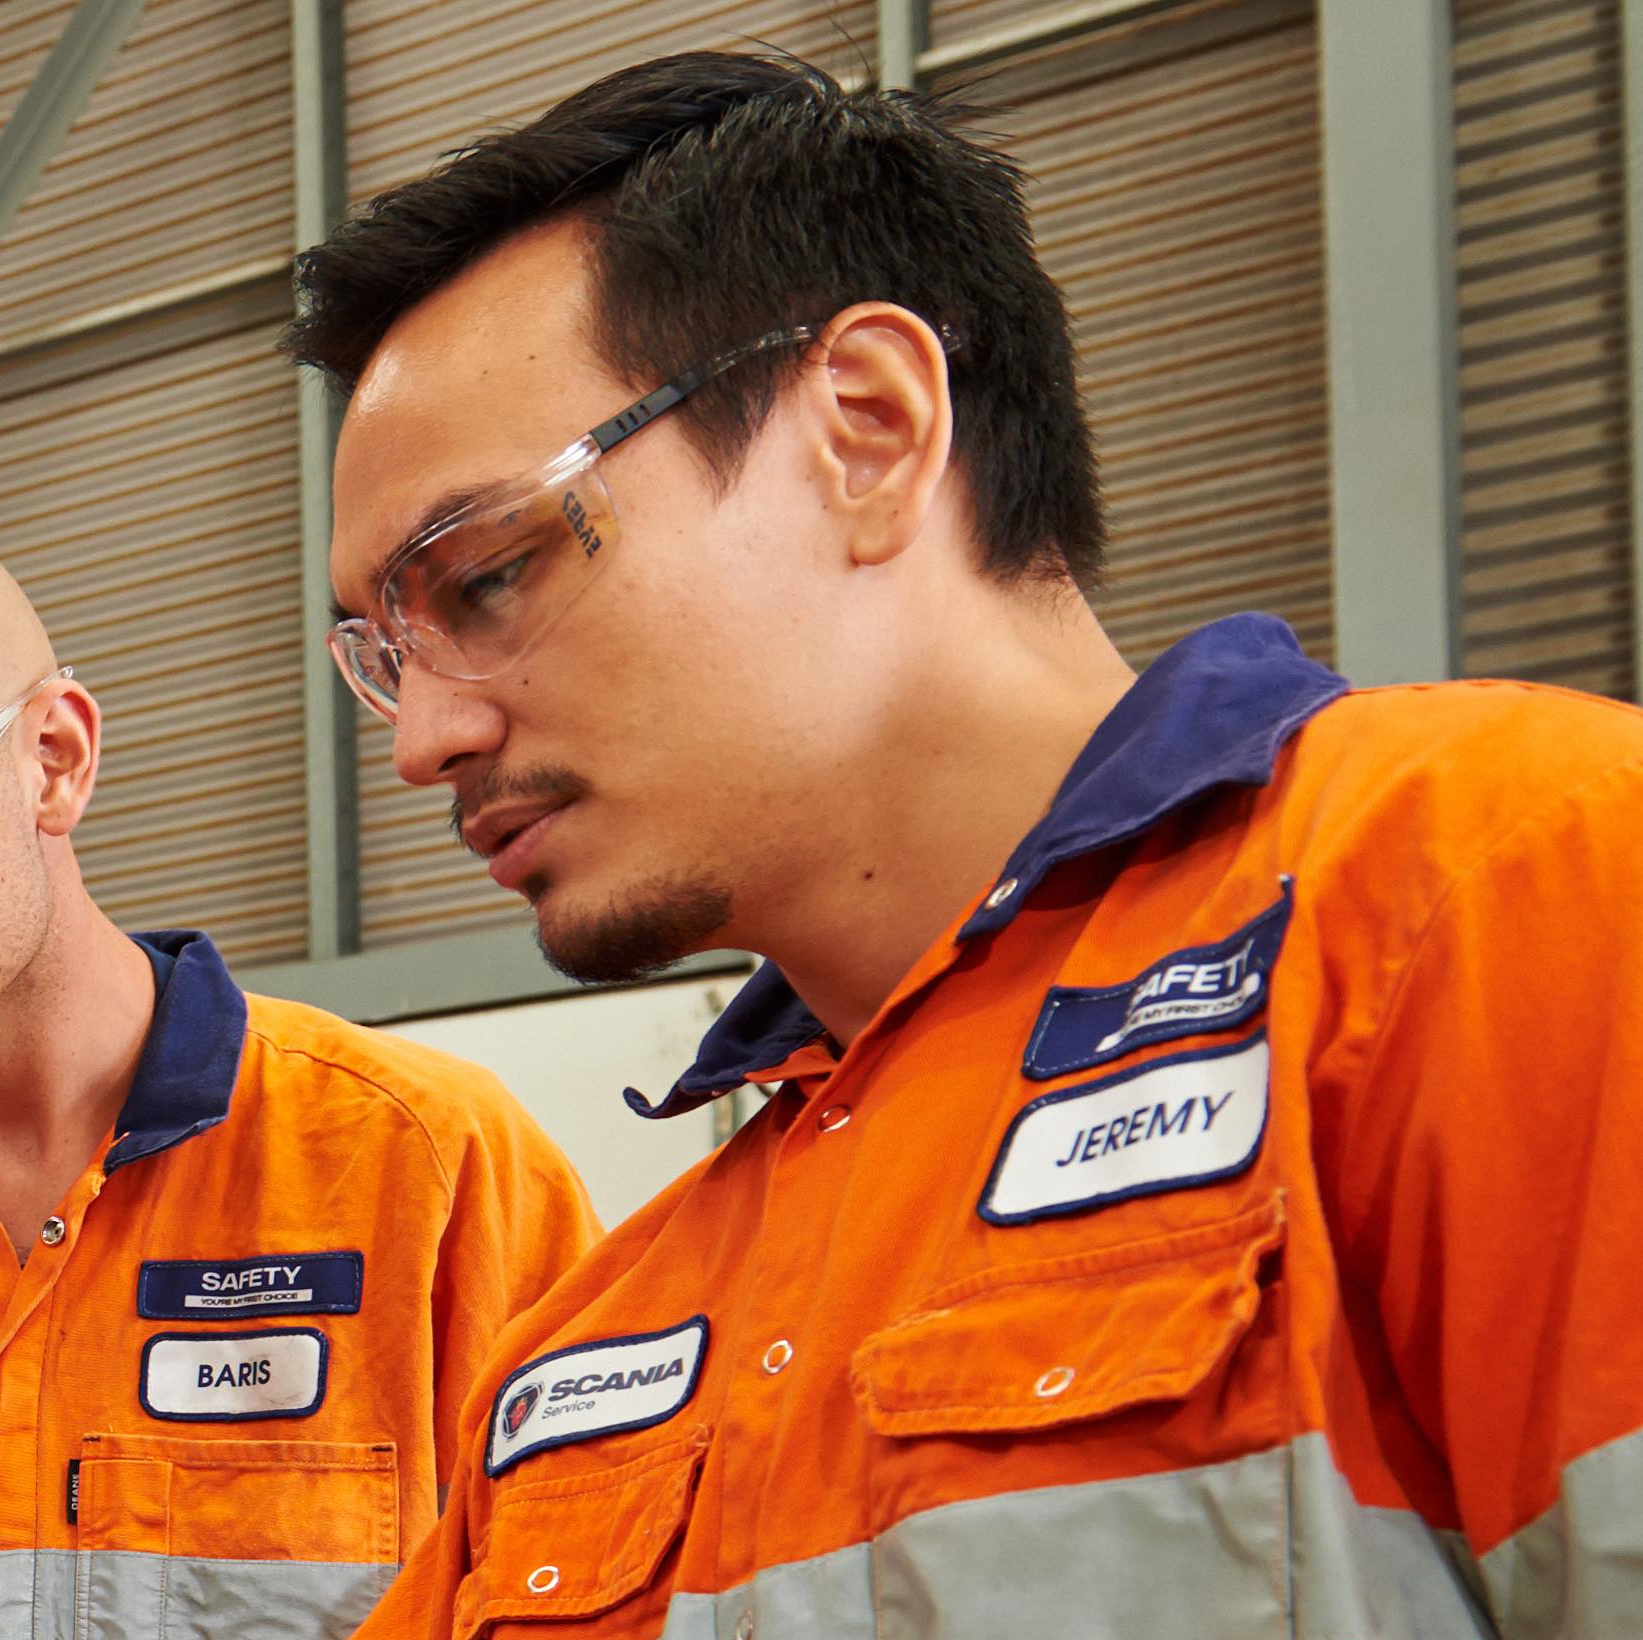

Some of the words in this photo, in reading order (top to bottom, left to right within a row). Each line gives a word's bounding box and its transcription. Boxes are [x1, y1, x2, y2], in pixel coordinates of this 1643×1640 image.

[1128, 939, 1255, 1008] AFET
[1056, 1090, 1235, 1167] JEREMY
[201, 1266, 302, 1291] SAFETY
[198, 1360, 271, 1387] BARIS
[548, 1357, 683, 1402] SCANIA
[542, 1400, 595, 1419] Service
